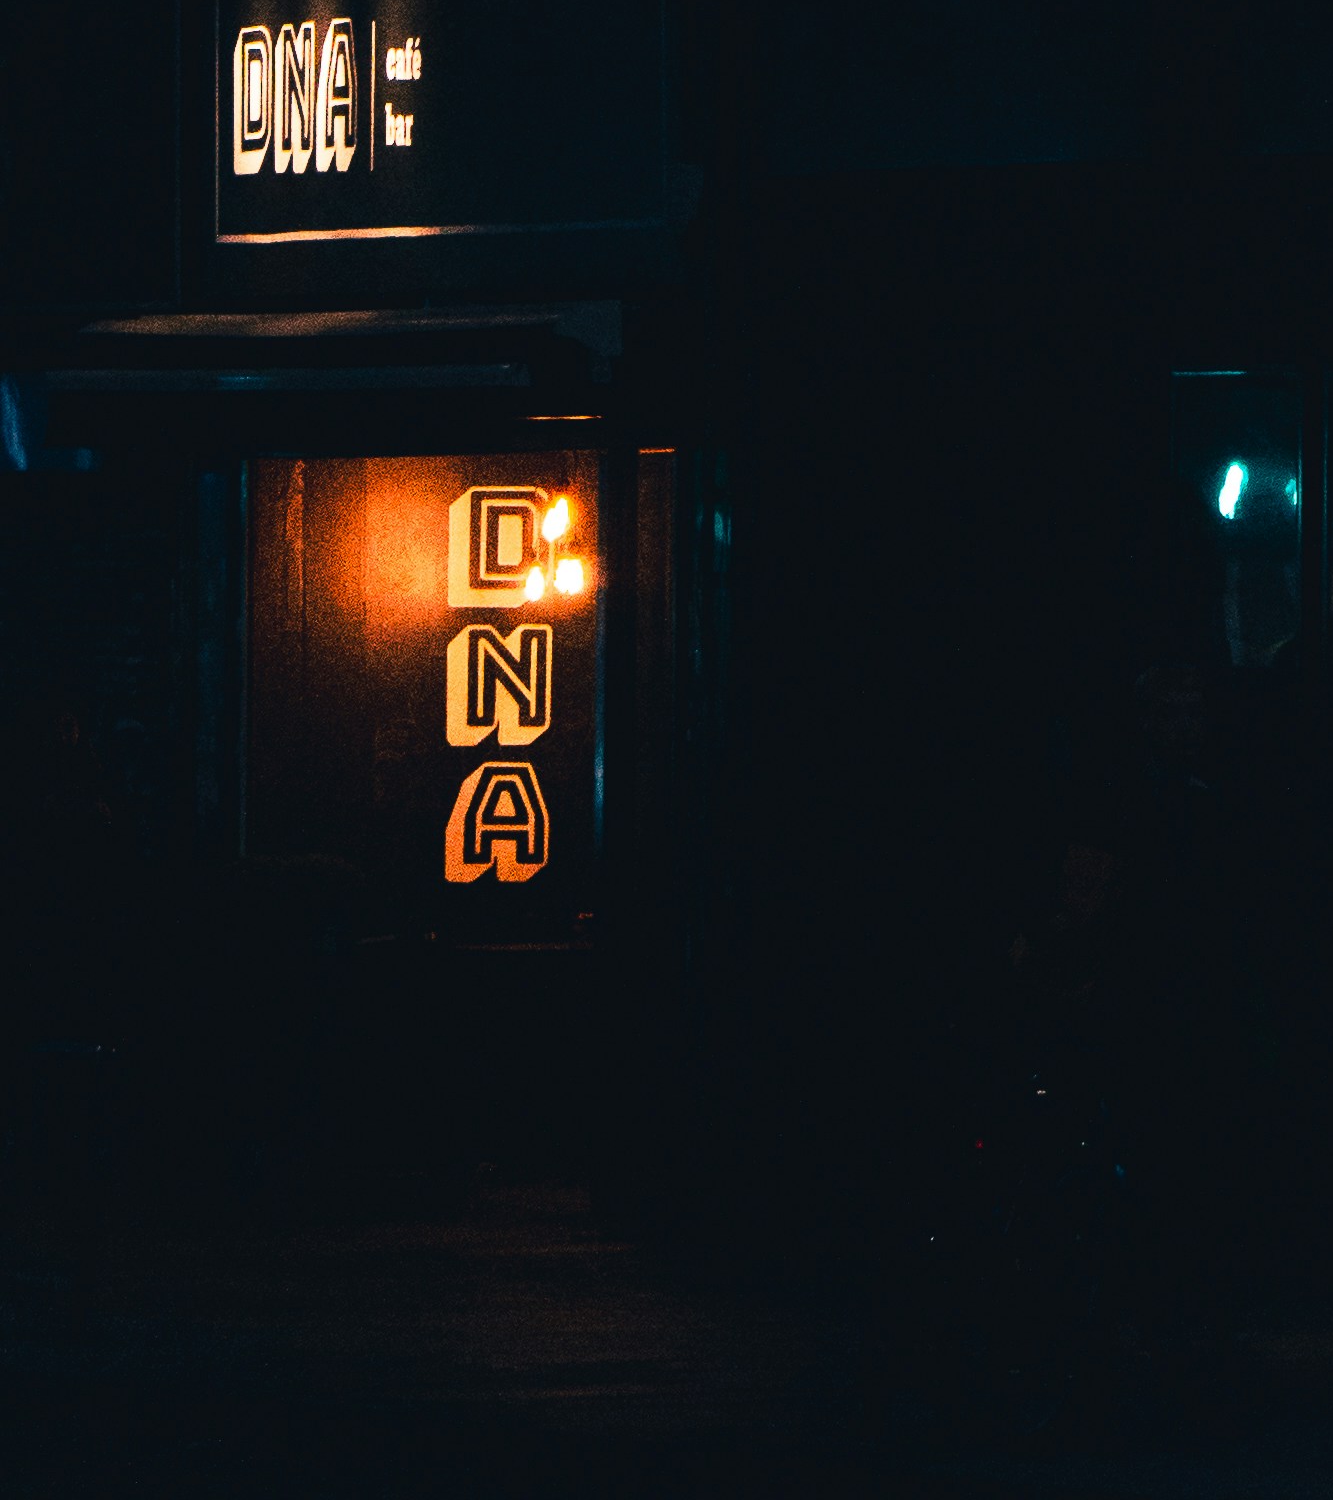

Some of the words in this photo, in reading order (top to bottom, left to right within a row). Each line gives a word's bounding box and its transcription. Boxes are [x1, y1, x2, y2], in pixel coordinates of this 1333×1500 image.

[233, 17, 358, 176] DNA
[385, 36, 423, 81] café
[384, 102, 415, 147] bar
[444, 485, 555, 883] DNA
